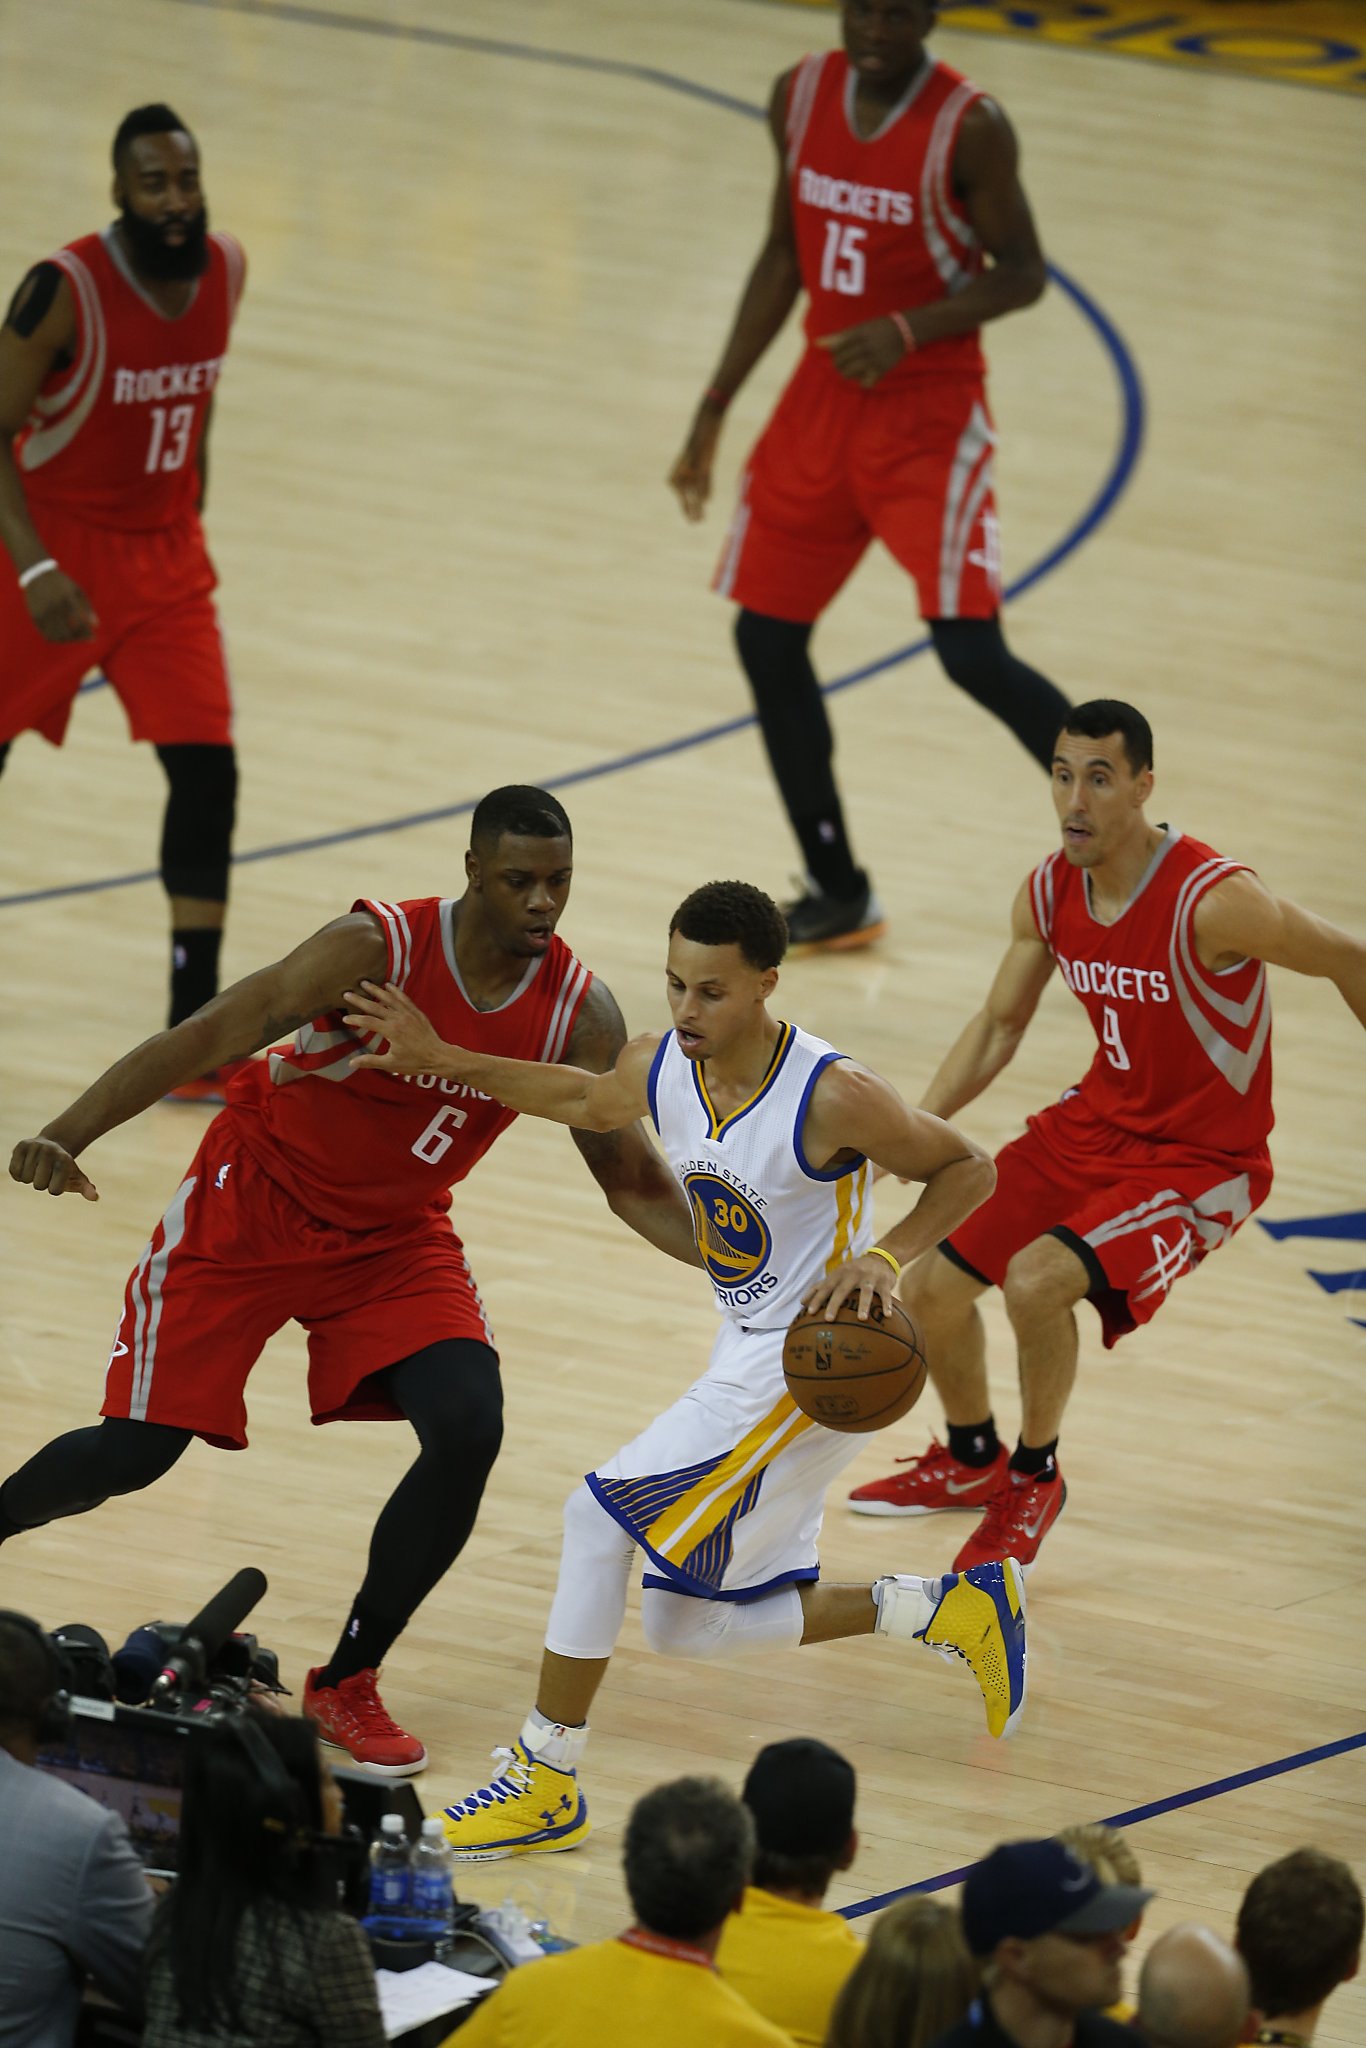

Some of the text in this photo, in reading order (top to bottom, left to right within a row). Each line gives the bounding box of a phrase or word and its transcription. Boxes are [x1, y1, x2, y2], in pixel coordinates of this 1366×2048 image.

[800, 168, 913, 225] ROCKETS
[820, 219, 867, 296] 15
[114, 358, 222, 404] ROCKET
[145, 405, 194, 473] 13
[1057, 953, 1171, 1003] ROCKETS
[1102, 1004, 1131, 1071] 9
[411, 1104, 468, 1165] 6
[713, 1198, 748, 1233] 30
[722, 1169, 768, 1210] STATE
[712, 1272, 778, 1307] RIORS
